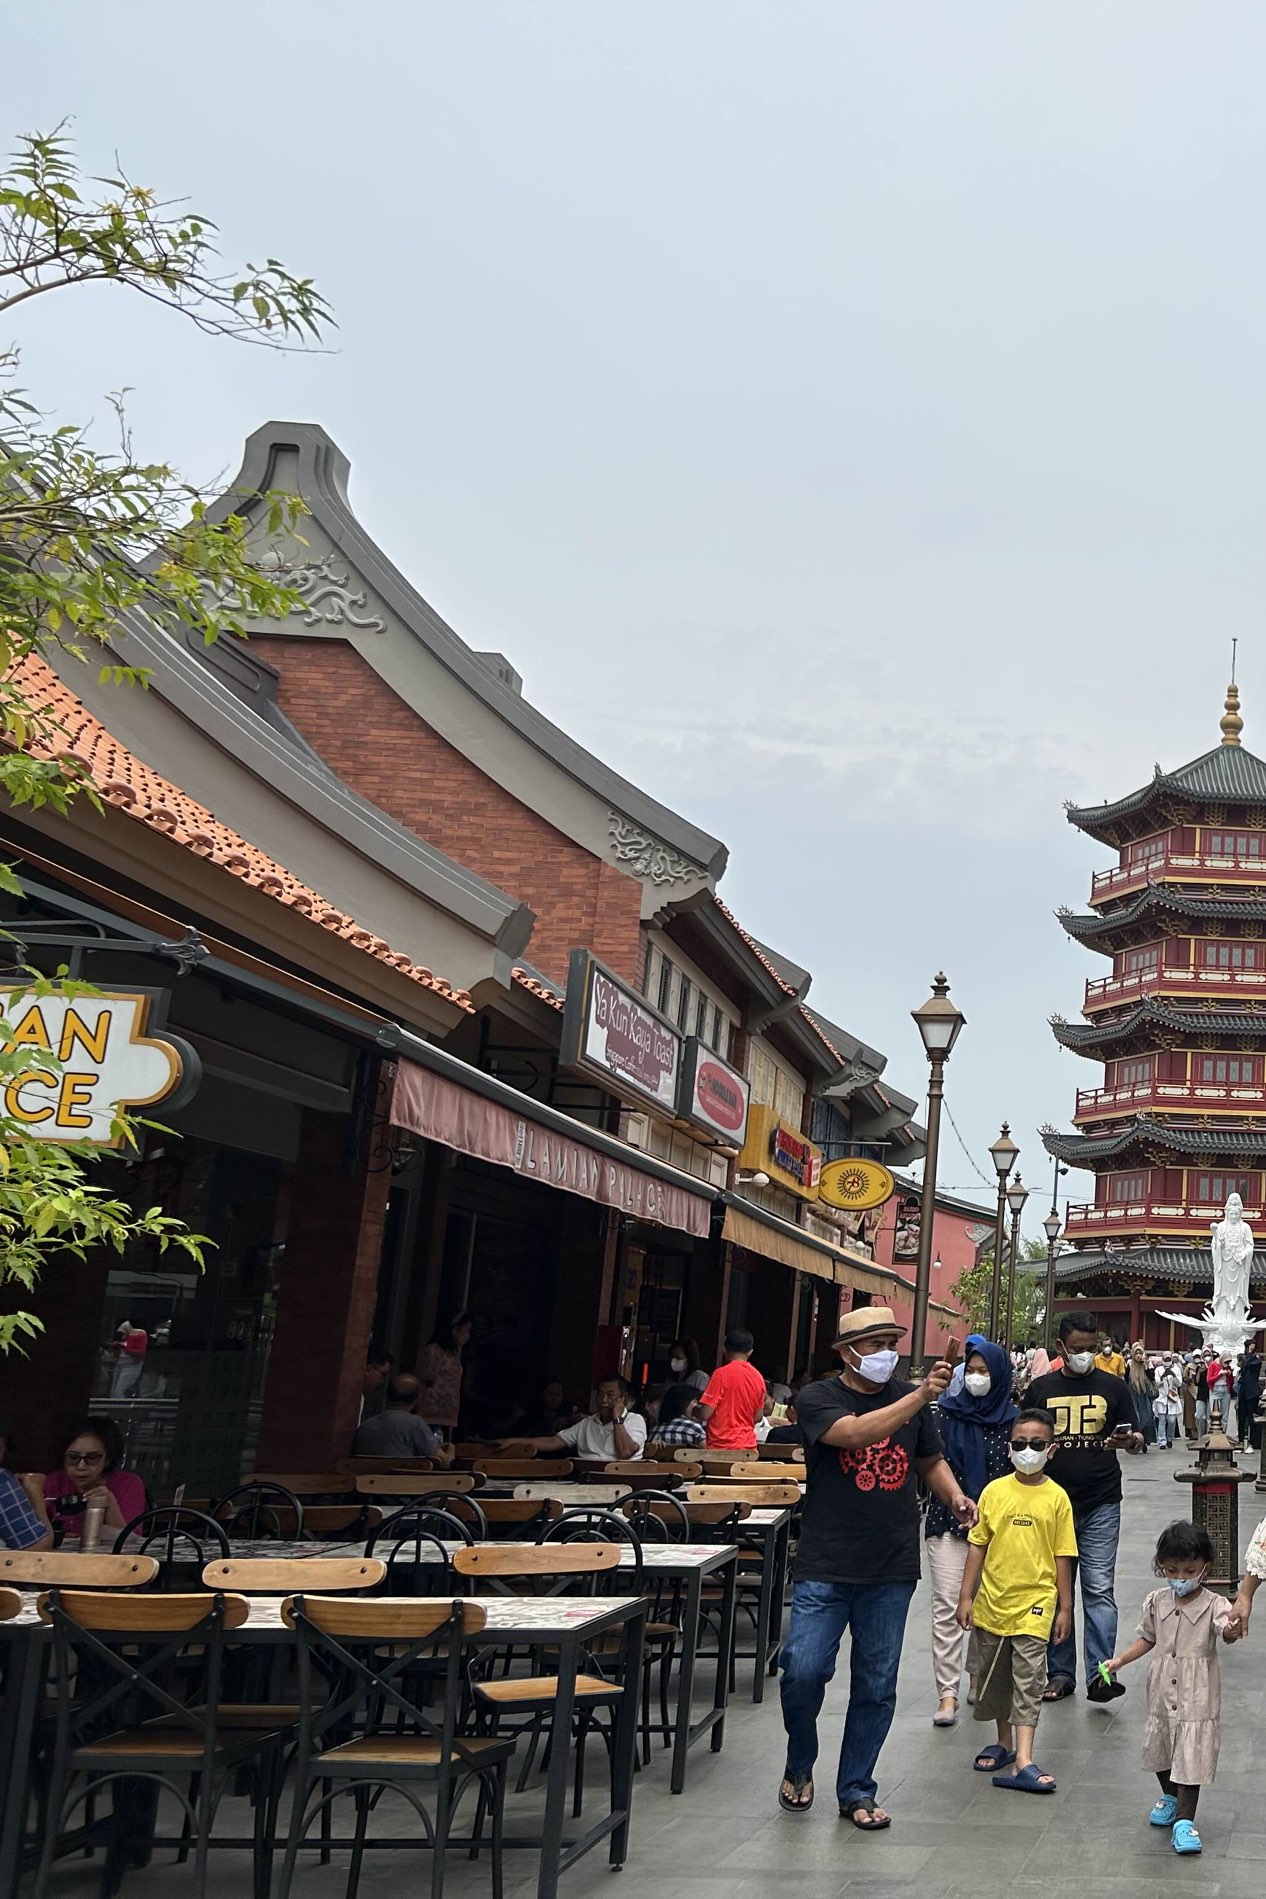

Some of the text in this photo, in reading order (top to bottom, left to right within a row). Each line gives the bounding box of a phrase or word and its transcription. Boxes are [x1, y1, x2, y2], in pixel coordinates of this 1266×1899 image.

[0, 1003, 112, 1064] AN
[596, 983, 674, 1068] Ya Kun Kaya Toast
[4, 1069, 99, 1128] CE
[527, 1130, 599, 1195] LAMIAN
